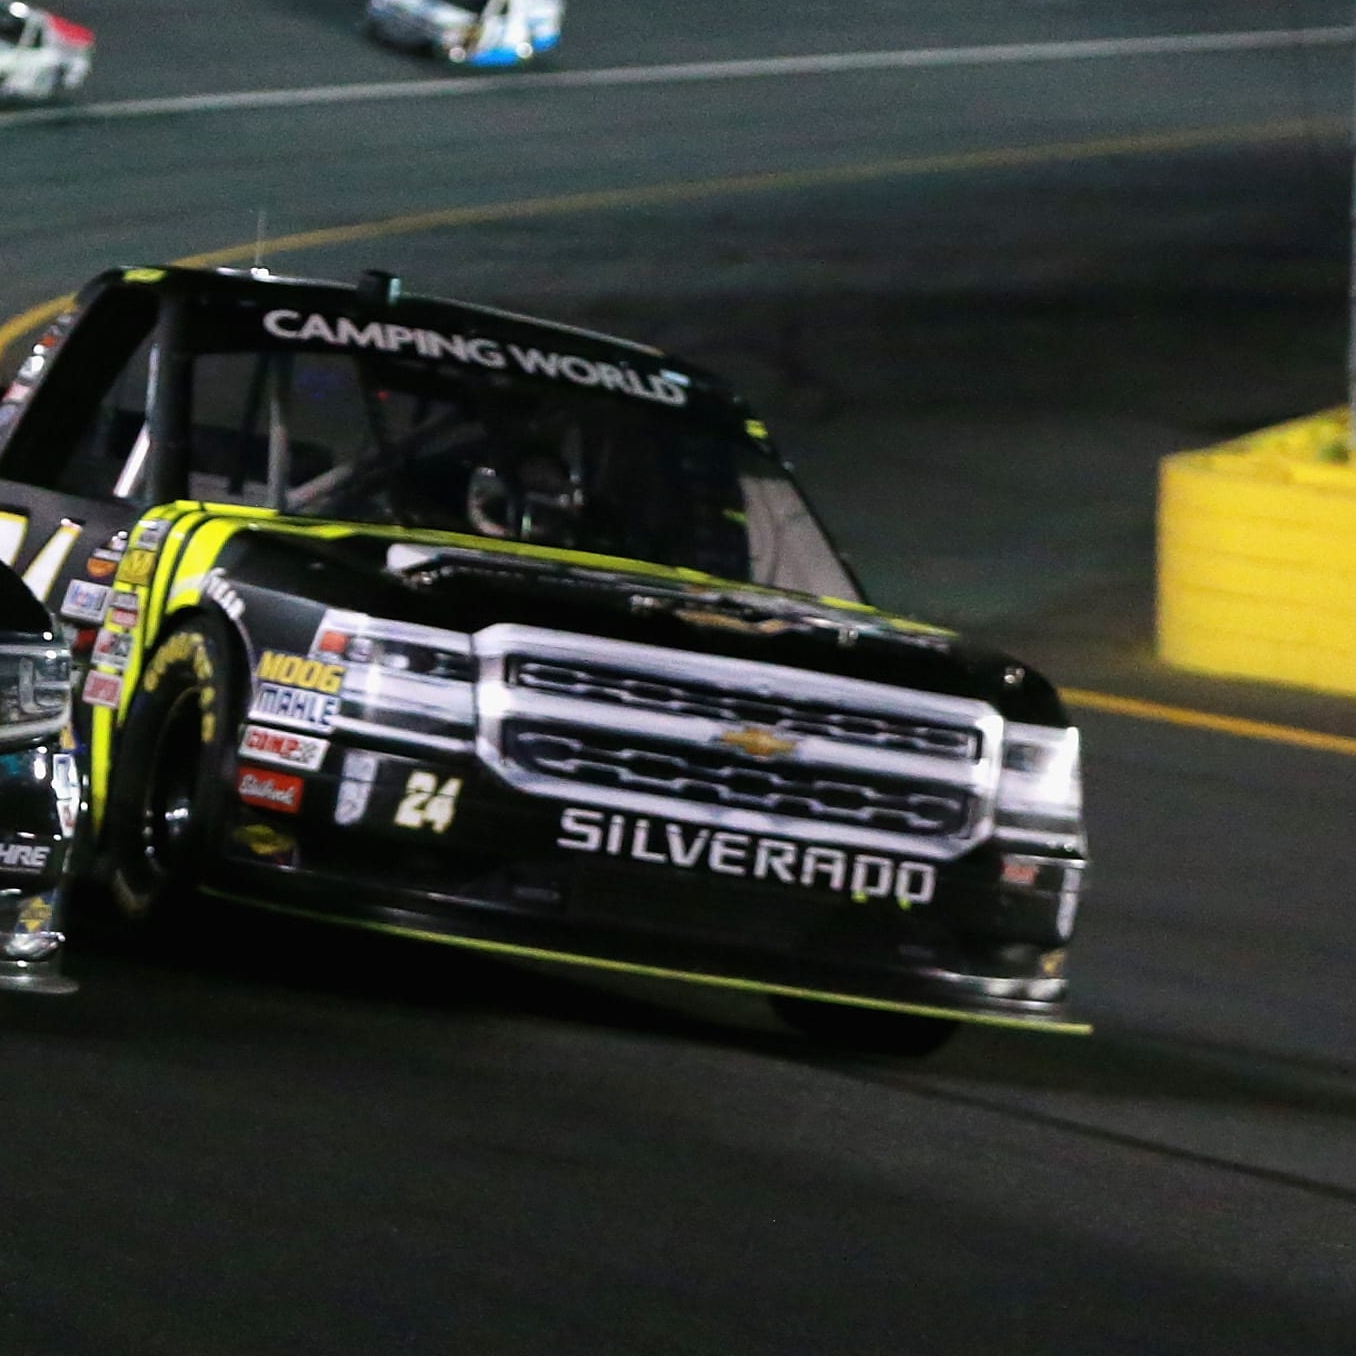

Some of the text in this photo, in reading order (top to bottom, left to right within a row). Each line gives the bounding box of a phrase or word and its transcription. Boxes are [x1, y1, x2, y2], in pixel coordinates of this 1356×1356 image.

[263, 309, 687, 407] CAMPING WORLD
[257, 650, 348, 694] MOOG
[394, 769, 464, 834] 24
[557, 807, 937, 906] SILVERADO
